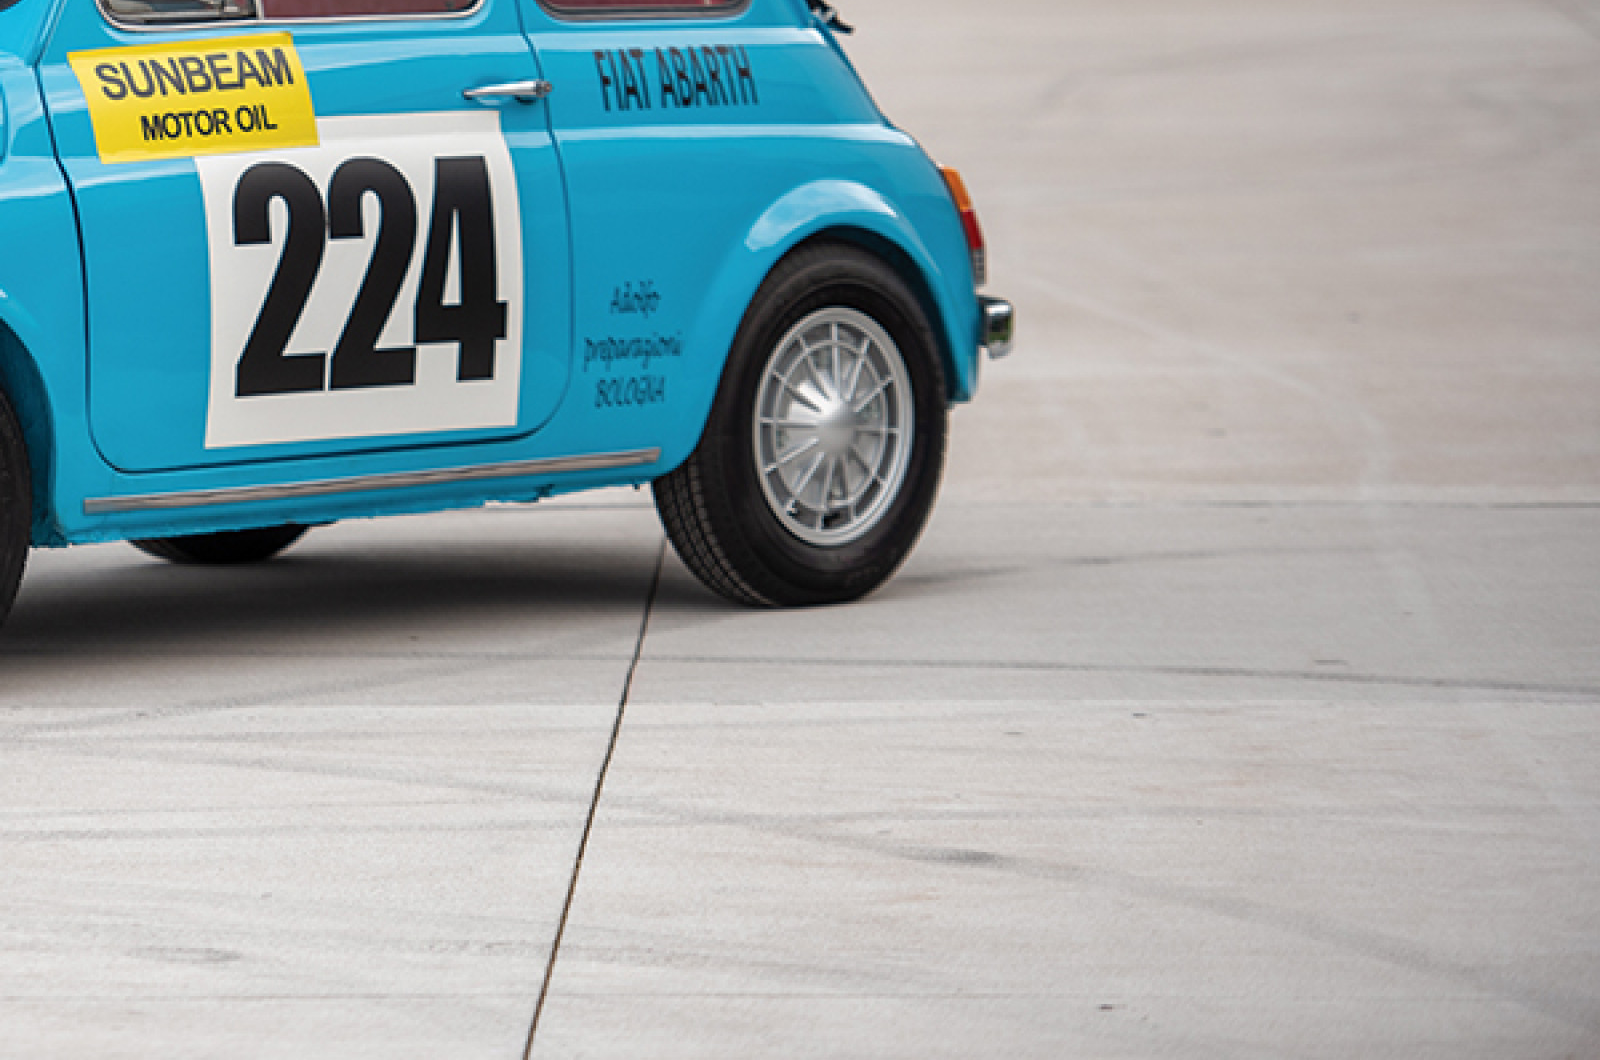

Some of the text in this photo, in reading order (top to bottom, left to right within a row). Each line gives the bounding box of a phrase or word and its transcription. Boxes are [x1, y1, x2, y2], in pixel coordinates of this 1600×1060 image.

[94, 48, 294, 100] SUNBEAM
[593, 43, 759, 111] FIAT ABARTH
[140, 104, 278, 141] MOTOR OIL
[233, 155, 508, 398] 224
[595, 375, 665, 408] BOLOGNA
